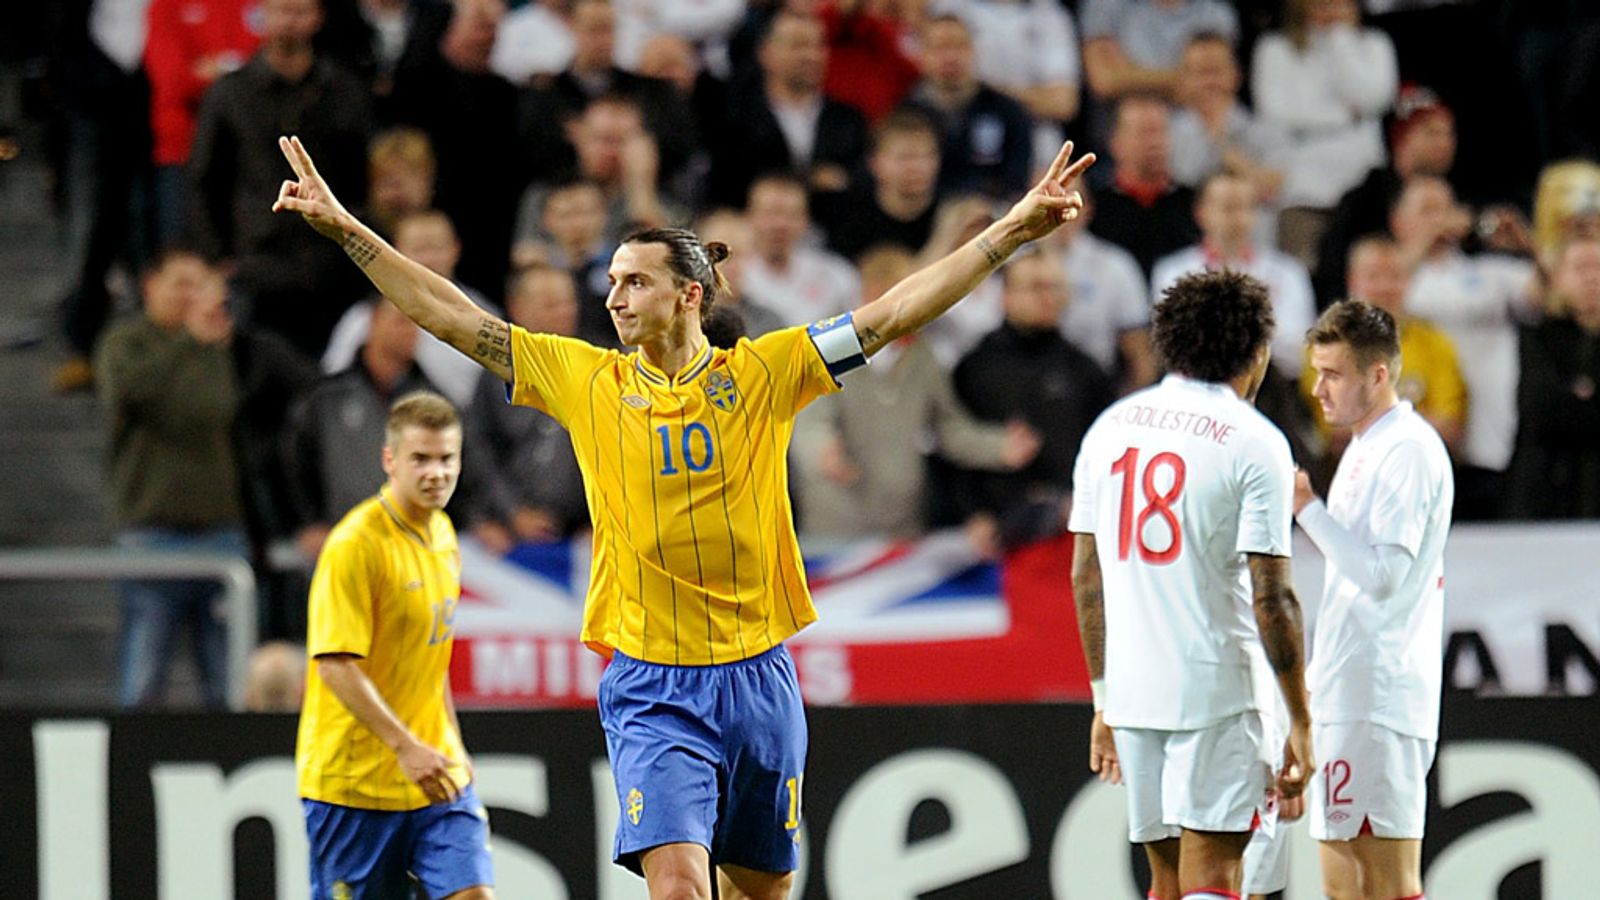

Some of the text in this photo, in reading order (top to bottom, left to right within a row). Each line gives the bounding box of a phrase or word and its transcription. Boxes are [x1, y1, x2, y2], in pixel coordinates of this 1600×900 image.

[655, 422, 714, 476] 10
[1110, 447, 1187, 566] 18
[428, 597, 457, 646] 19
[1323, 759, 1354, 808] 12
